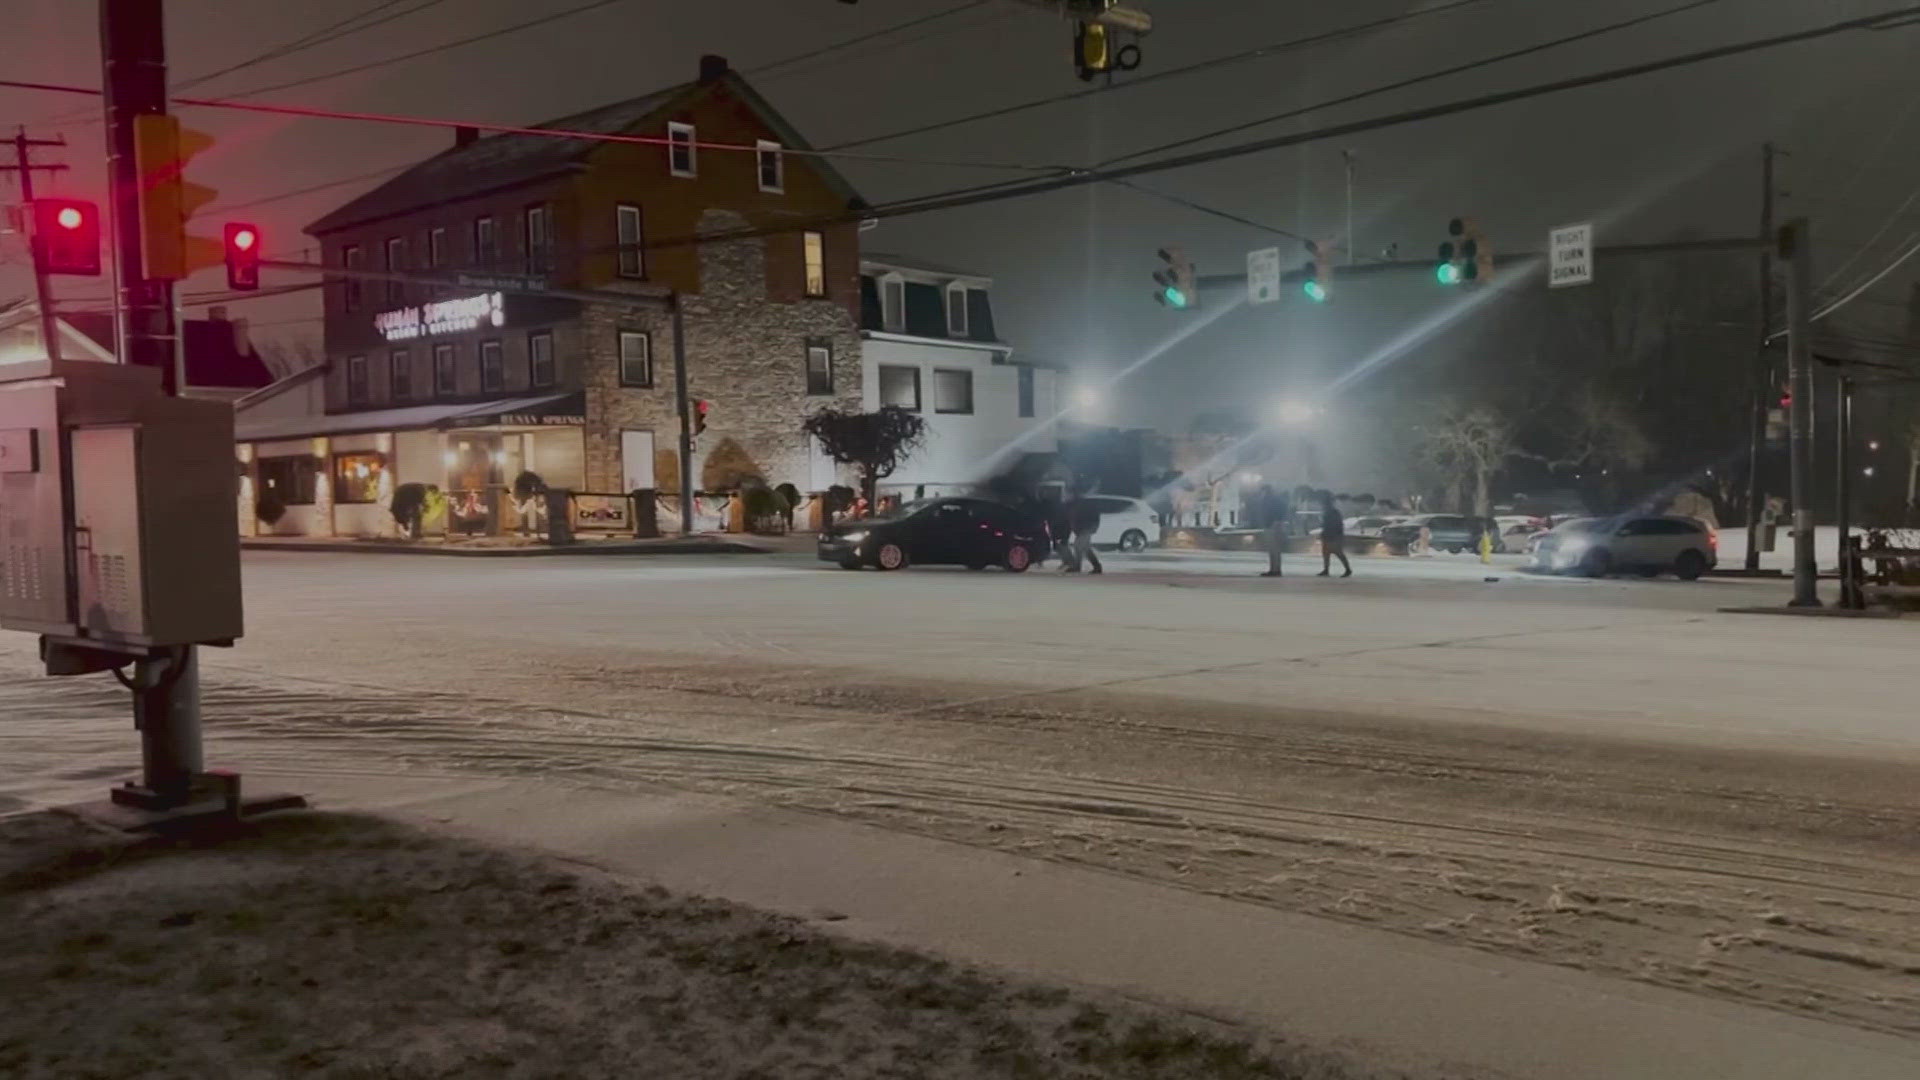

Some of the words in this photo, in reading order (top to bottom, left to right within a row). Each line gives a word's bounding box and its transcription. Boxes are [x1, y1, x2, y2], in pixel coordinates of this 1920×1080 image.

[1555, 230, 1584, 244] RIGHT
[1558, 248, 1584, 262] TURN
[1553, 264, 1588, 280] SIGNAL
[542, 415, 585, 425] SPRINGS
